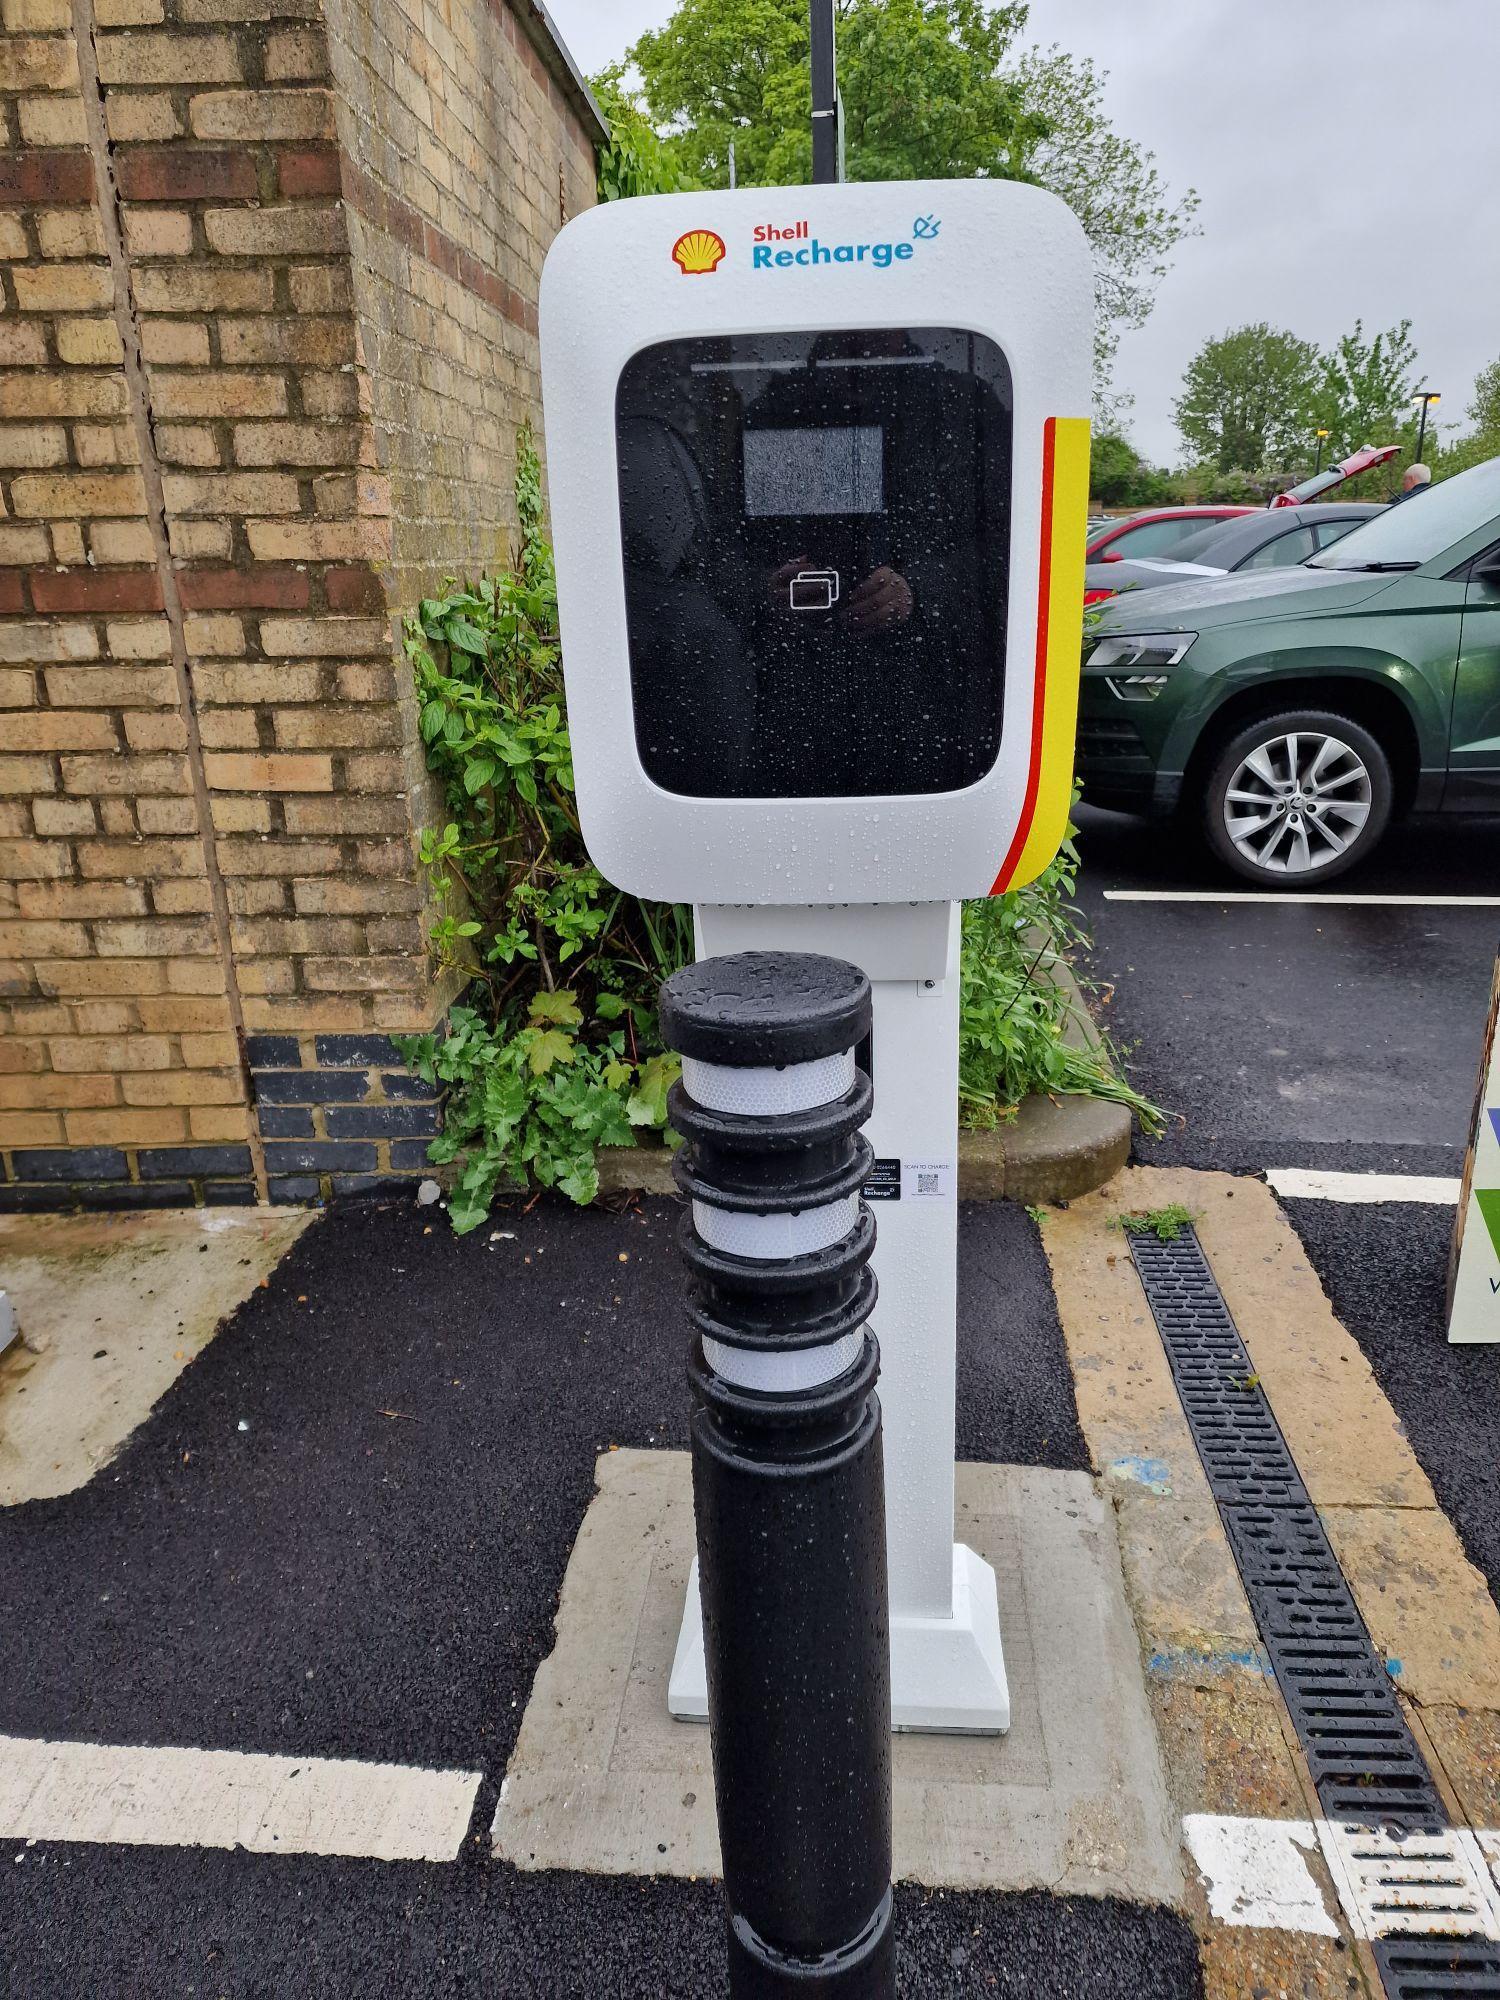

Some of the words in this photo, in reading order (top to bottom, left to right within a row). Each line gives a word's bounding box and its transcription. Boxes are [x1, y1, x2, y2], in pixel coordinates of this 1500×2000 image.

[753, 221, 809, 242] Shell
[753, 239, 914, 268] Recharge
[864, 1189, 891, 1197] Recharge
